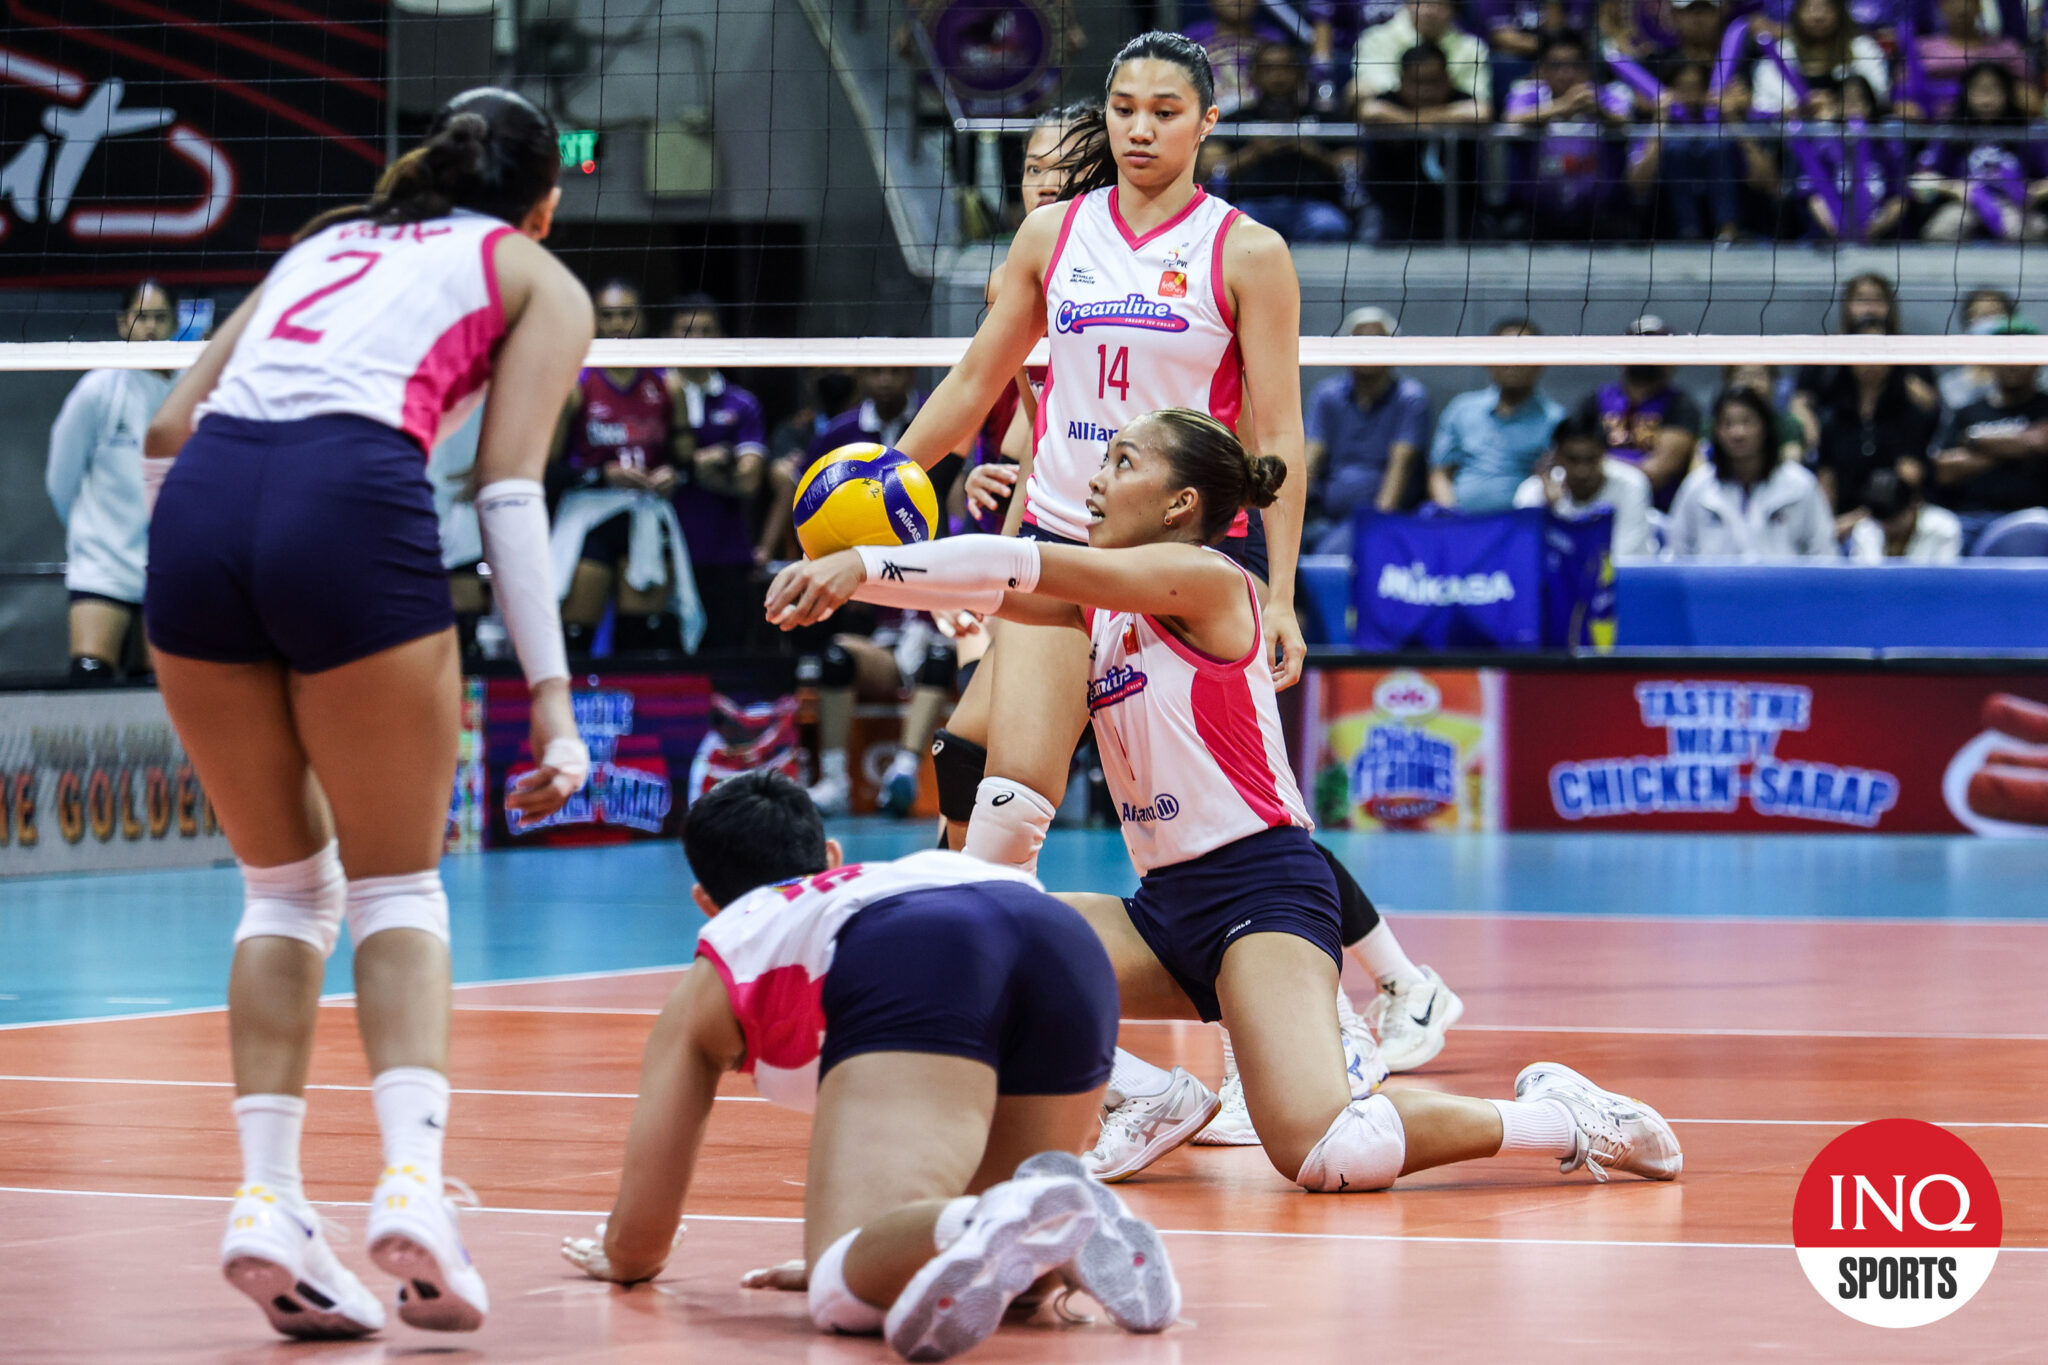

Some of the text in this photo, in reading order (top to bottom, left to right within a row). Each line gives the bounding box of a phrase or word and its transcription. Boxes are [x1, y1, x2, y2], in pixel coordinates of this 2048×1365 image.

[271, 250, 381, 343] 2
[1057, 294, 1170, 334] Creamline
[1097, 344, 1130, 401] 14
[895, 507, 923, 543] MiKAS
